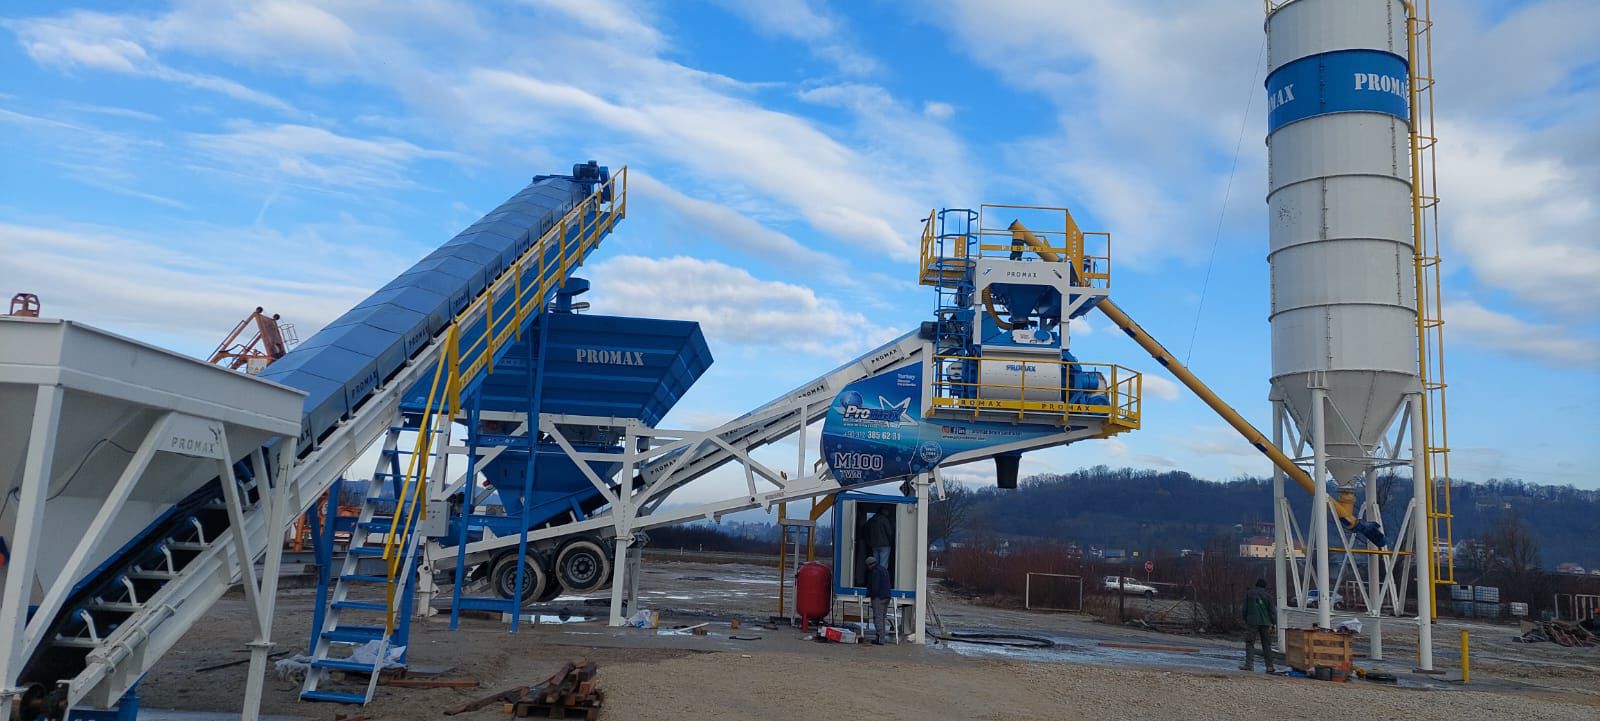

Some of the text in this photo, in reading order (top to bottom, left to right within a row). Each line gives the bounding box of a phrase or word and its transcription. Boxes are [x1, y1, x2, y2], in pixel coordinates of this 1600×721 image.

[577, 349, 644, 366] PROMAX
[871, 349, 898, 364] PROMAX
[352, 371, 378, 398] PROMAX
[172, 437, 214, 453] PROMAX
[834, 452, 883, 470] M100
